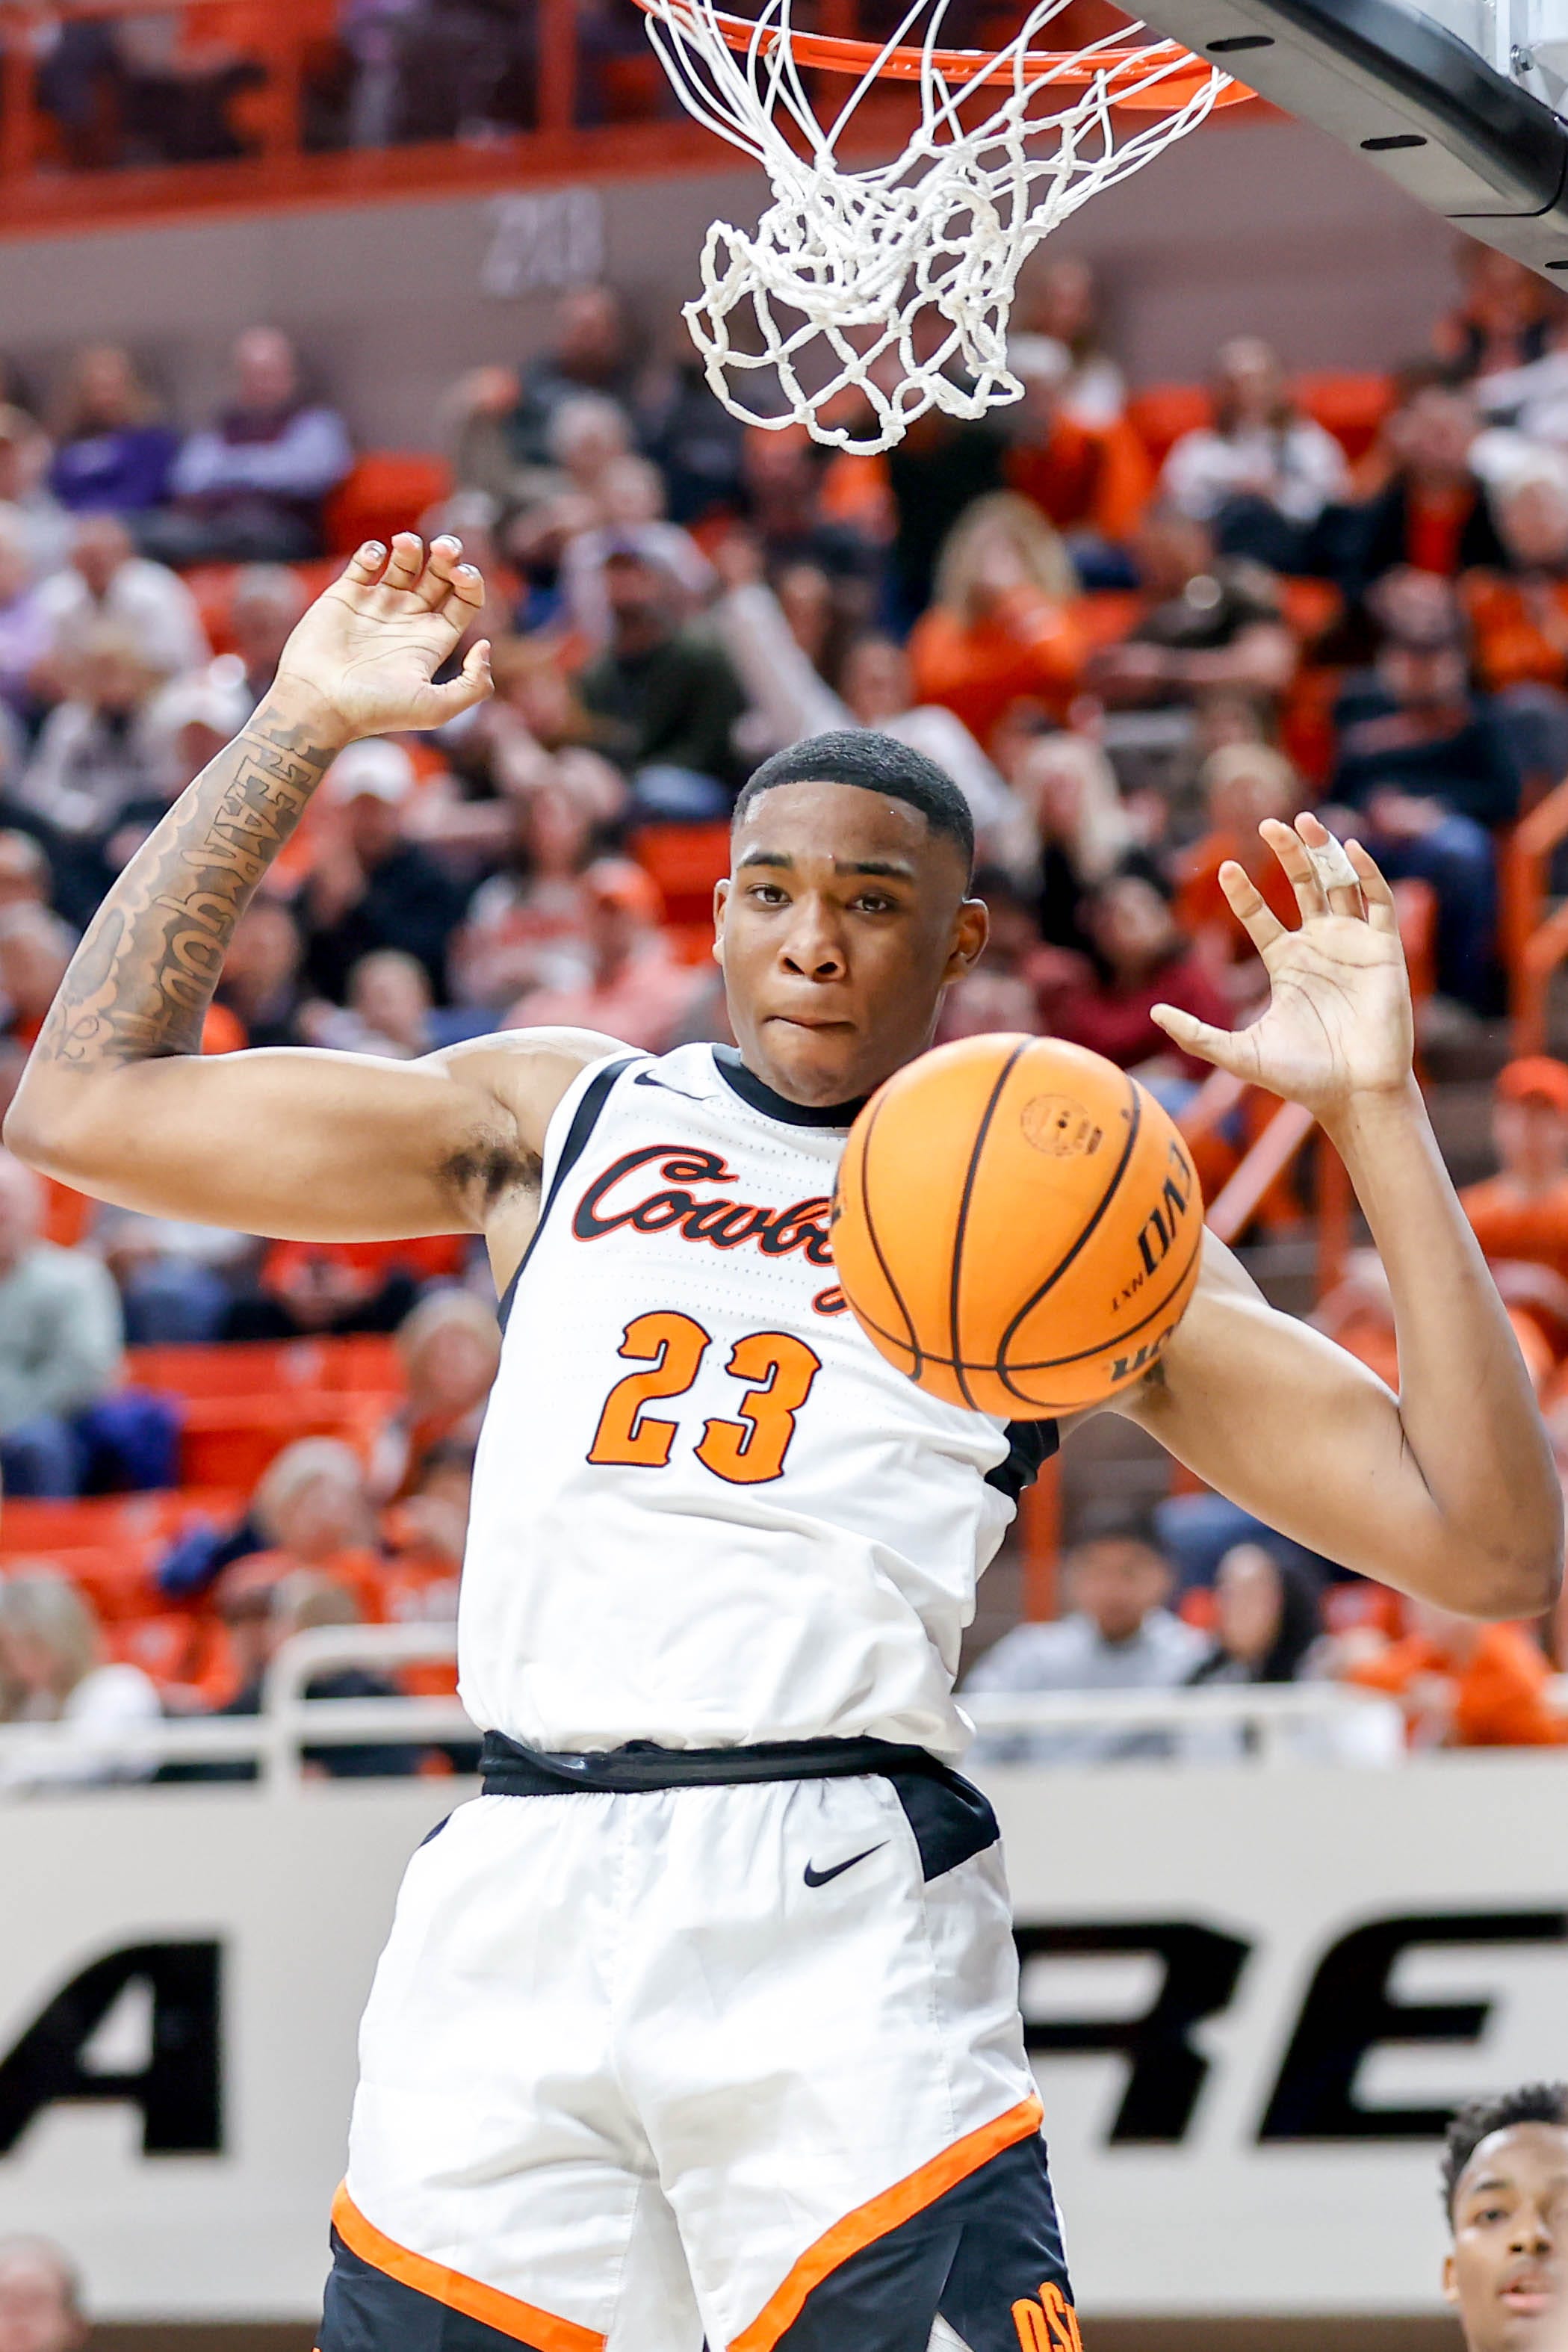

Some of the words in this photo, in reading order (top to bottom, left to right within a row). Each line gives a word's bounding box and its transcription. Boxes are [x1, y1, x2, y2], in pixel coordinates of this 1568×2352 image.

[180, 731, 323, 883] FEAR
[152, 891, 238, 1013] GOD
[586, 1310, 822, 1485] 23
